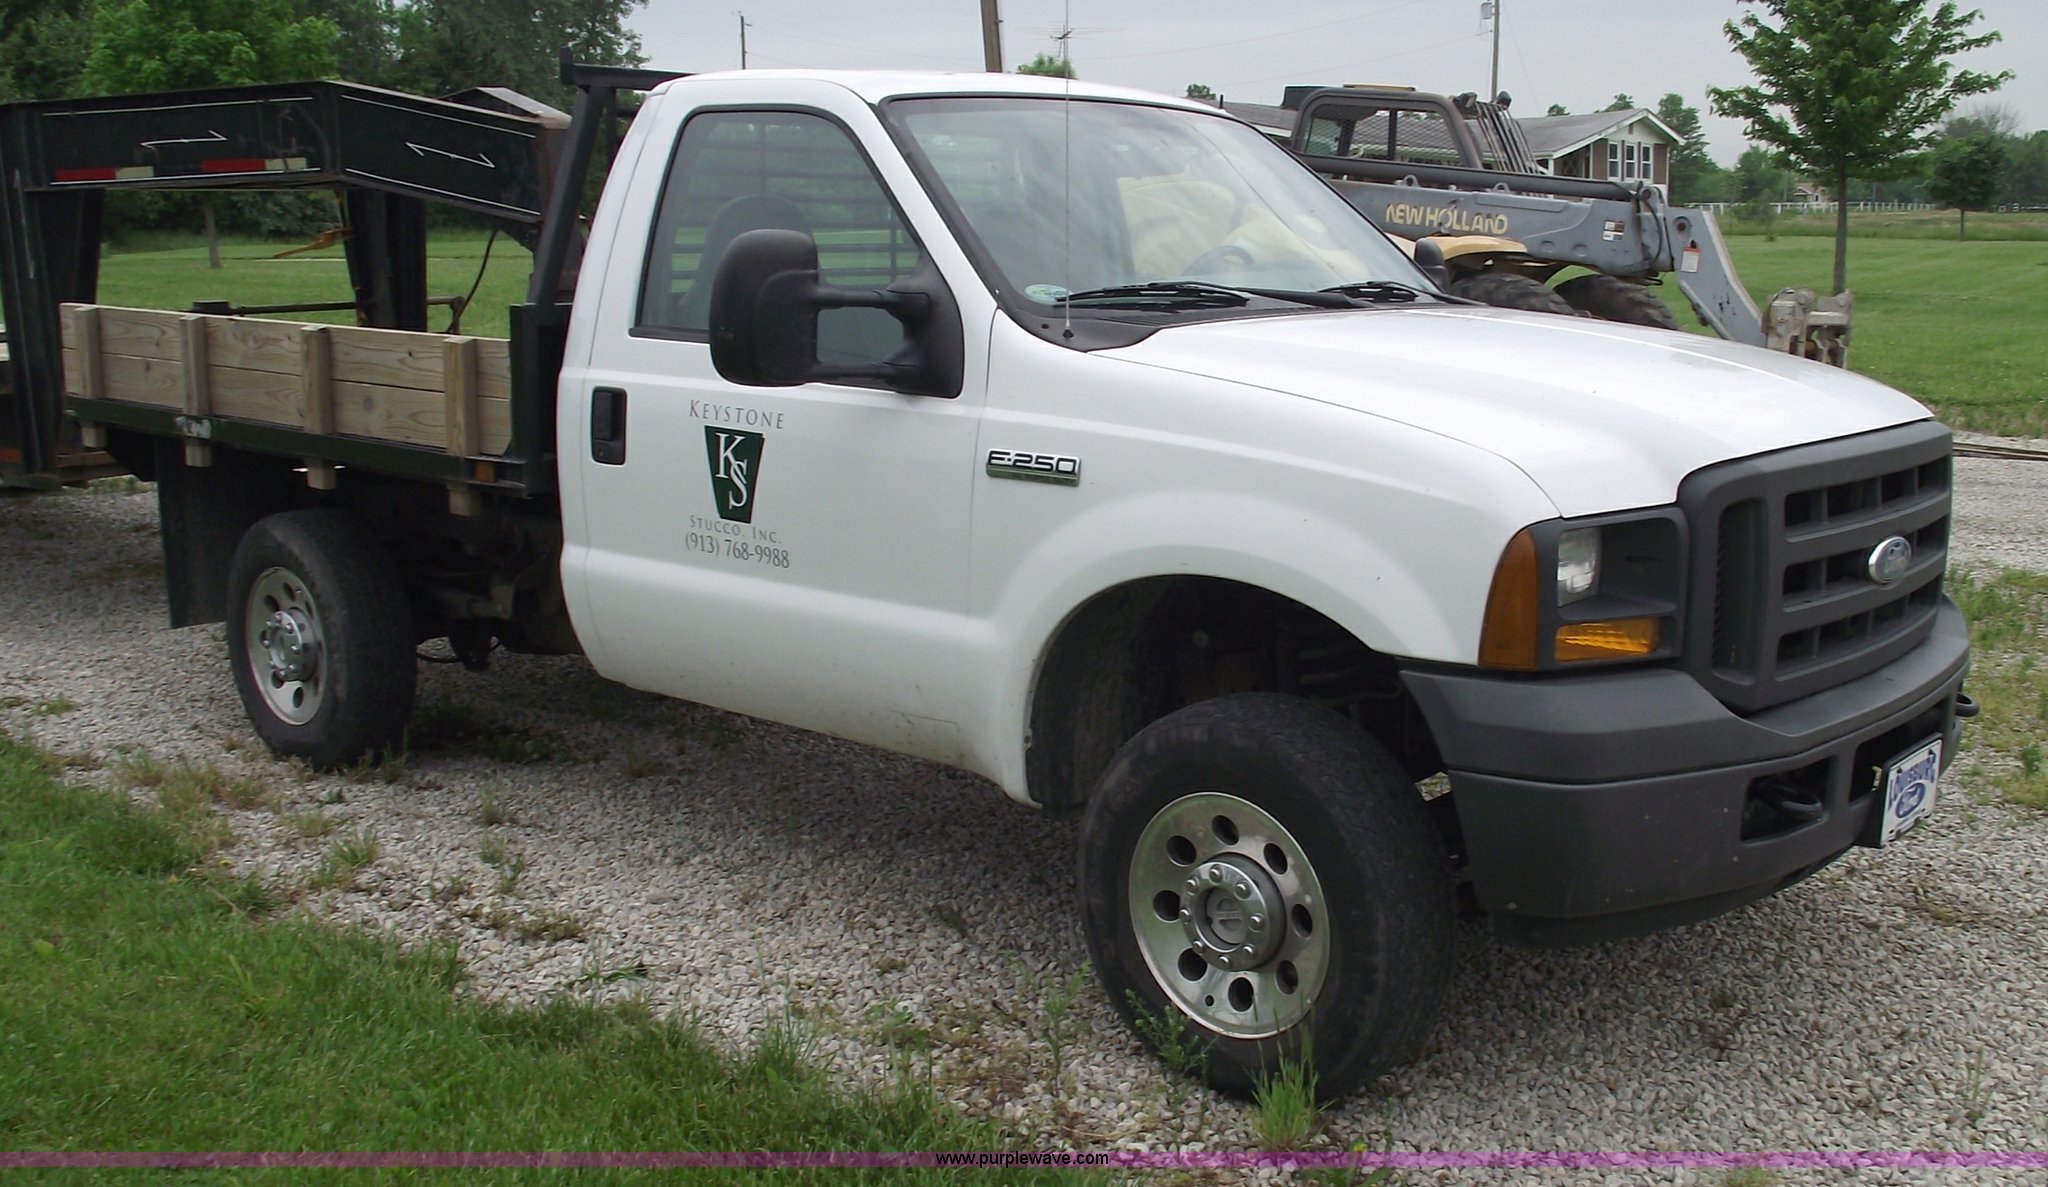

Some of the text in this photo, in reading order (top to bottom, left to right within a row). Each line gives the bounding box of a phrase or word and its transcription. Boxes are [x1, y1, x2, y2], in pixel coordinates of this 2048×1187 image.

[1386, 203, 1508, 235] NEW HOLLAND
[689, 399, 784, 429] KEYSTONE
[987, 449, 1079, 476] F-250
[685, 532, 791, 569] (913) 768-9988
[752, 527, 783, 545] INC.
